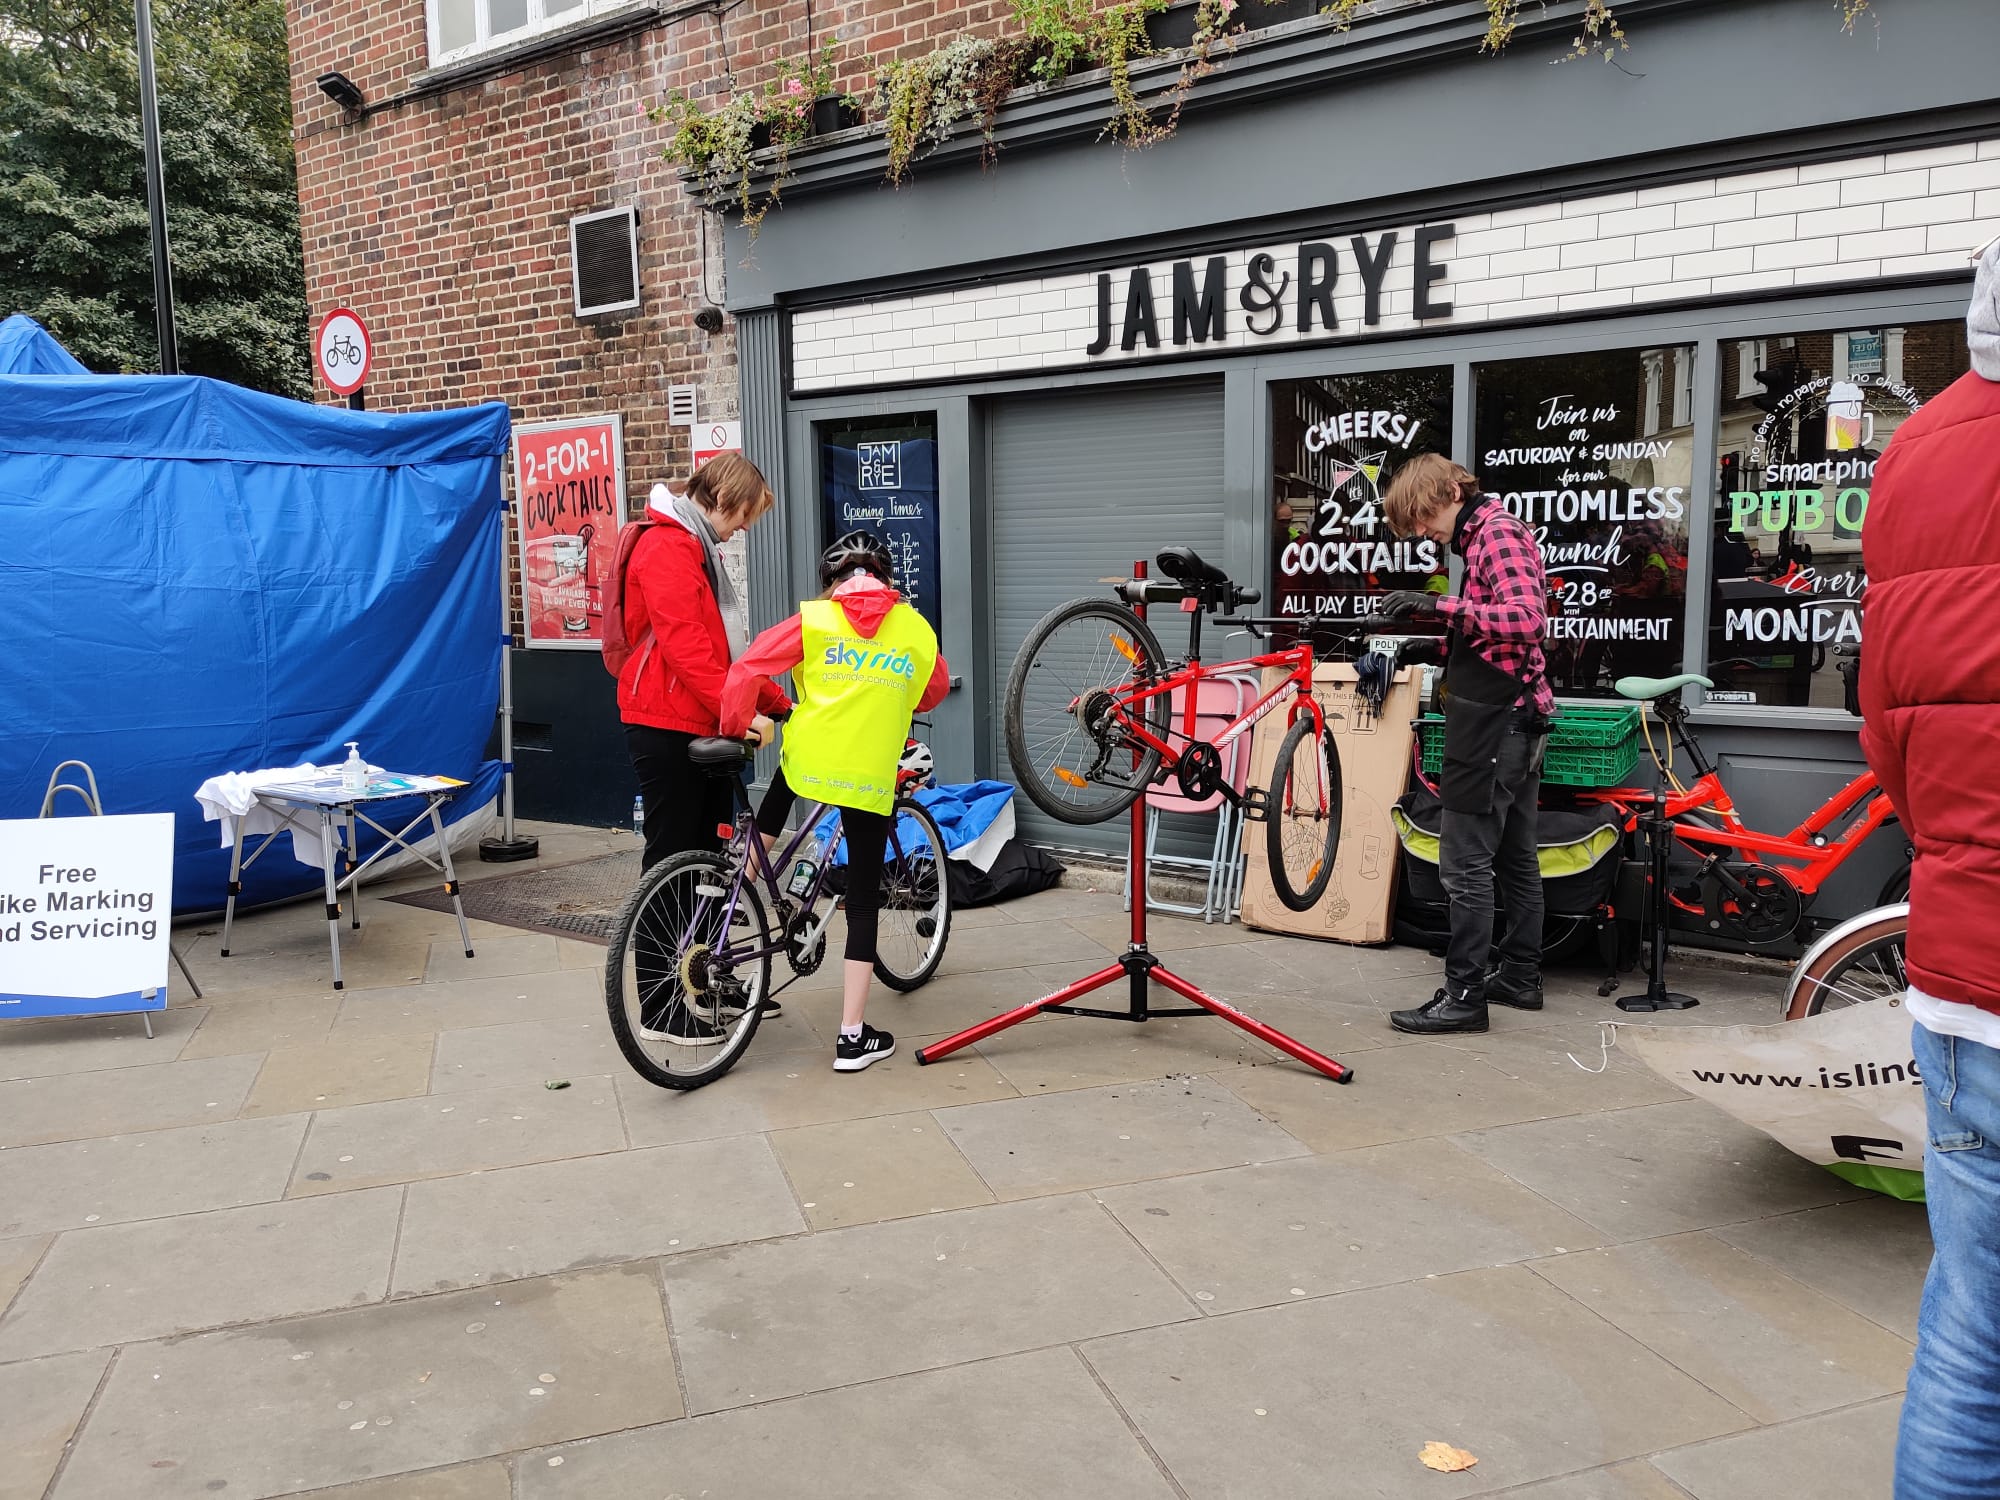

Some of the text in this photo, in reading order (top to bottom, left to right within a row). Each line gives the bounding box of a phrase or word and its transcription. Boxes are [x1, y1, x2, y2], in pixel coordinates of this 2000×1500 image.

[1536, 394, 1621, 431] Join us
[1749, 447, 1760, 463] no
[1755, 413, 1776, 443] pens
[1777, 393, 1795, 409] no
[1793, 376, 1832, 400] paper
[1851, 373, 1870, 383] no
[1305, 410, 1421, 453] CHEERS!
[1568, 428, 1590, 442] on
[525, 431, 608, 486] 2-FOR-1
[860, 443, 896, 465] JAM
[1484, 446, 1576, 467] SATURDAY
[1592, 440, 1673, 461] SUNDAY
[861, 465, 895, 487] RYE
[1558, 468, 1608, 487] for our
[1766, 457, 1879, 486] smartpho
[527, 475, 612, 530] COCKTAILS
[843, 496, 922, 527] Opening Times
[1728, 489, 1825, 533] PUB
[1280, 539, 1439, 577] COCKTAILS
[1784, 567, 1869, 597] Ever
[593, 602, 603, 612] DA
[1282, 595, 1384, 614] ALL DAY EVE
[1545, 617, 1673, 641] TERTAINMENT
[1725, 607, 1865, 643] MONDA
[1375, 640, 1395, 649] POLI
[825, 642, 915, 679] sky ride
[1333, 692, 1348, 700] THIS
[39, 864, 97, 884] Free
[0, 889, 153, 914] ike Marking
[30, 917, 157, 941] Servicing
[1691, 1059, 1924, 1089] www.isling
